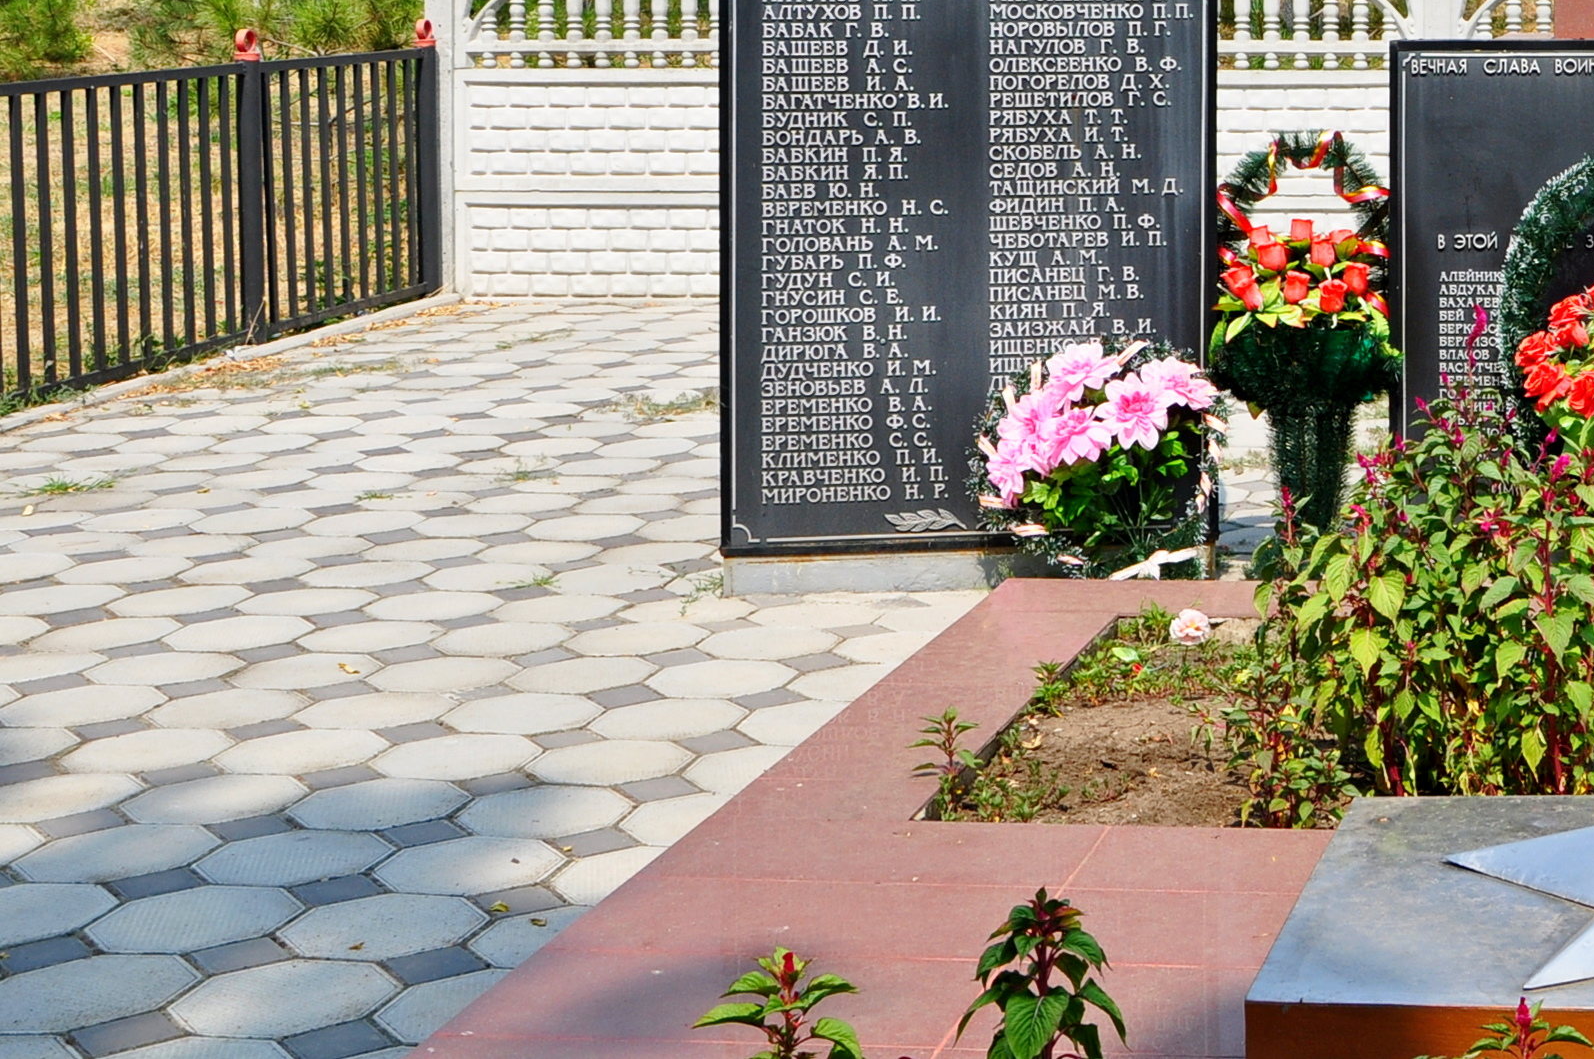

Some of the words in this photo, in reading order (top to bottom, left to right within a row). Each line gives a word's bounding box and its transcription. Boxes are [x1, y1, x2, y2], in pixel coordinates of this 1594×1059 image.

[761, 3, 862, 20] АЛТУХОВ
[989, 3, 1144, 20] МОСКОВЧЕНКО
[761, 21, 834, 38] БАБАК
[989, 20, 1116, 37] НОРОВЫЛОВ
[761, 39, 849, 56] БАШЕЕВ
[989, 38, 1087, 55] НАГУЛОВ
[761, 57, 849, 74] БАШЕЕВ
[988, 56, 1123, 73] ОЛЕКСЕЕНКО
[1411, 58, 1468, 75] ВЕЧНАЯ
[1483, 58, 1541, 74] СЛАВА
[761, 75, 850, 92] БАШЕЕВ
[988, 73, 1110, 90] ПОГОРЕЛОВ
[761, 93, 897, 110] БАГАТЧЕНКО
[989, 91, 1115, 108] РЕШЕТИЛОВ
[761, 111, 849, 129] БУДНИК
[988, 109, 1073, 126] РЯБУХА
[761, 129, 864, 147] БОНДАРЬ
[988, 126, 1074, 143] РЯБУХА
[761, 147, 849, 164] БАБКИН
[988, 144, 1083, 161] СКОБЕЛЬ
[761, 164, 850, 181] БАБКИН
[988, 162, 1058, 180] СЕДОВ
[761, 182, 817, 199] БАЕВ
[988, 176, 1120, 197] ТАЩИНСКИЙ
[761, 200, 888, 217] ВЕРЕМЕНКО
[988, 197, 1065, 215] ФИДИН
[761, 218, 847, 235] ГНАТОК
[988, 215, 1102, 232] ШЕВЧЕНКО
[761, 236, 874, 253] ГОЛОВАНЬ
[988, 232, 1110, 249] ЧЕБОТАРЕВ
[1437, 234, 1446, 250] В
[1453, 231, 1498, 250] ЭТОЙ
[761, 254, 845, 271] ГУБАРЬ
[988, 250, 1039, 268] КУЩ
[761, 272, 834, 290] ГУДУН
[988, 268, 1087, 286] ПИСАНЕЦ
[761, 290, 846, 307] ГНУСИН
[988, 285, 1089, 303] ПИСАНЕЦ
[760, 308, 877, 325] ГОРОШКОВ
[988, 303, 1049, 320] КИЯН
[760, 325, 849, 342] ГАНЗЮК
[988, 317, 1097, 338] ЗАИЗЖАЙ
[761, 343, 850, 361] ДИРЮГА
[761, 361, 875, 379] ДУДЧЕНКО
[760, 379, 867, 396] ЗЕНОВЬЕВ
[760, 397, 873, 414] ЕРЕМЕНКО
[760, 415, 874, 432] ЕРЕМЕНКО
[761, 433, 874, 450] ЕРЕМЕНКО
[761, 451, 881, 468] КЛИМЕНКО
[761, 469, 886, 486] КРАВЧЕНКО
[761, 486, 892, 504] МИРОНЕНКО
